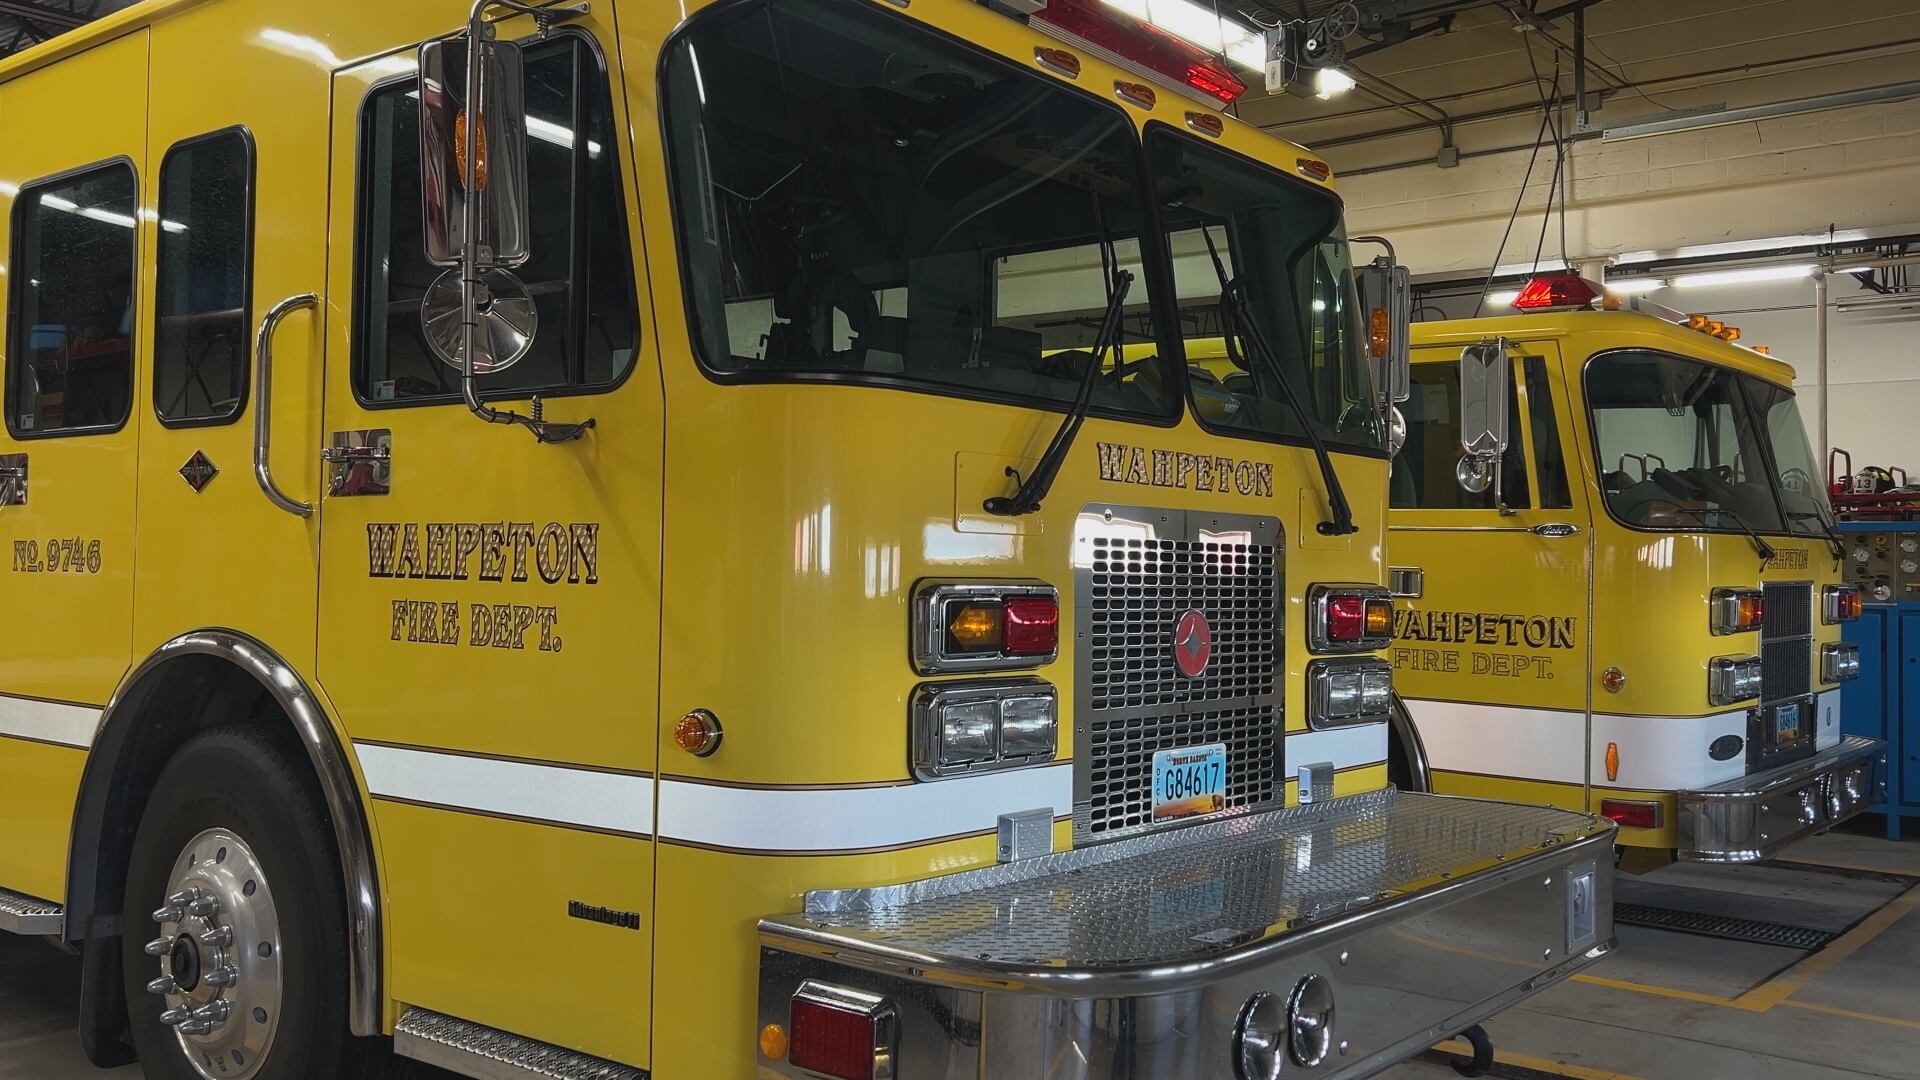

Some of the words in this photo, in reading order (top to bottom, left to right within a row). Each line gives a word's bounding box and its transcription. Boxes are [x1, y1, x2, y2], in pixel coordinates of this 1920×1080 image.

[1096, 442, 1273, 497] WAHPETON
[1856, 479, 1872, 489] 13
[47, 536, 101, 573] 9746
[367, 520, 599, 584] WAHPETON
[391, 599, 460, 646] FIRE
[470, 603, 562, 653] DEPT.
[1394, 648, 1459, 672] FIRE
[1472, 652, 1554, 679] DEPT.
[1165, 763, 1219, 801] G84617
